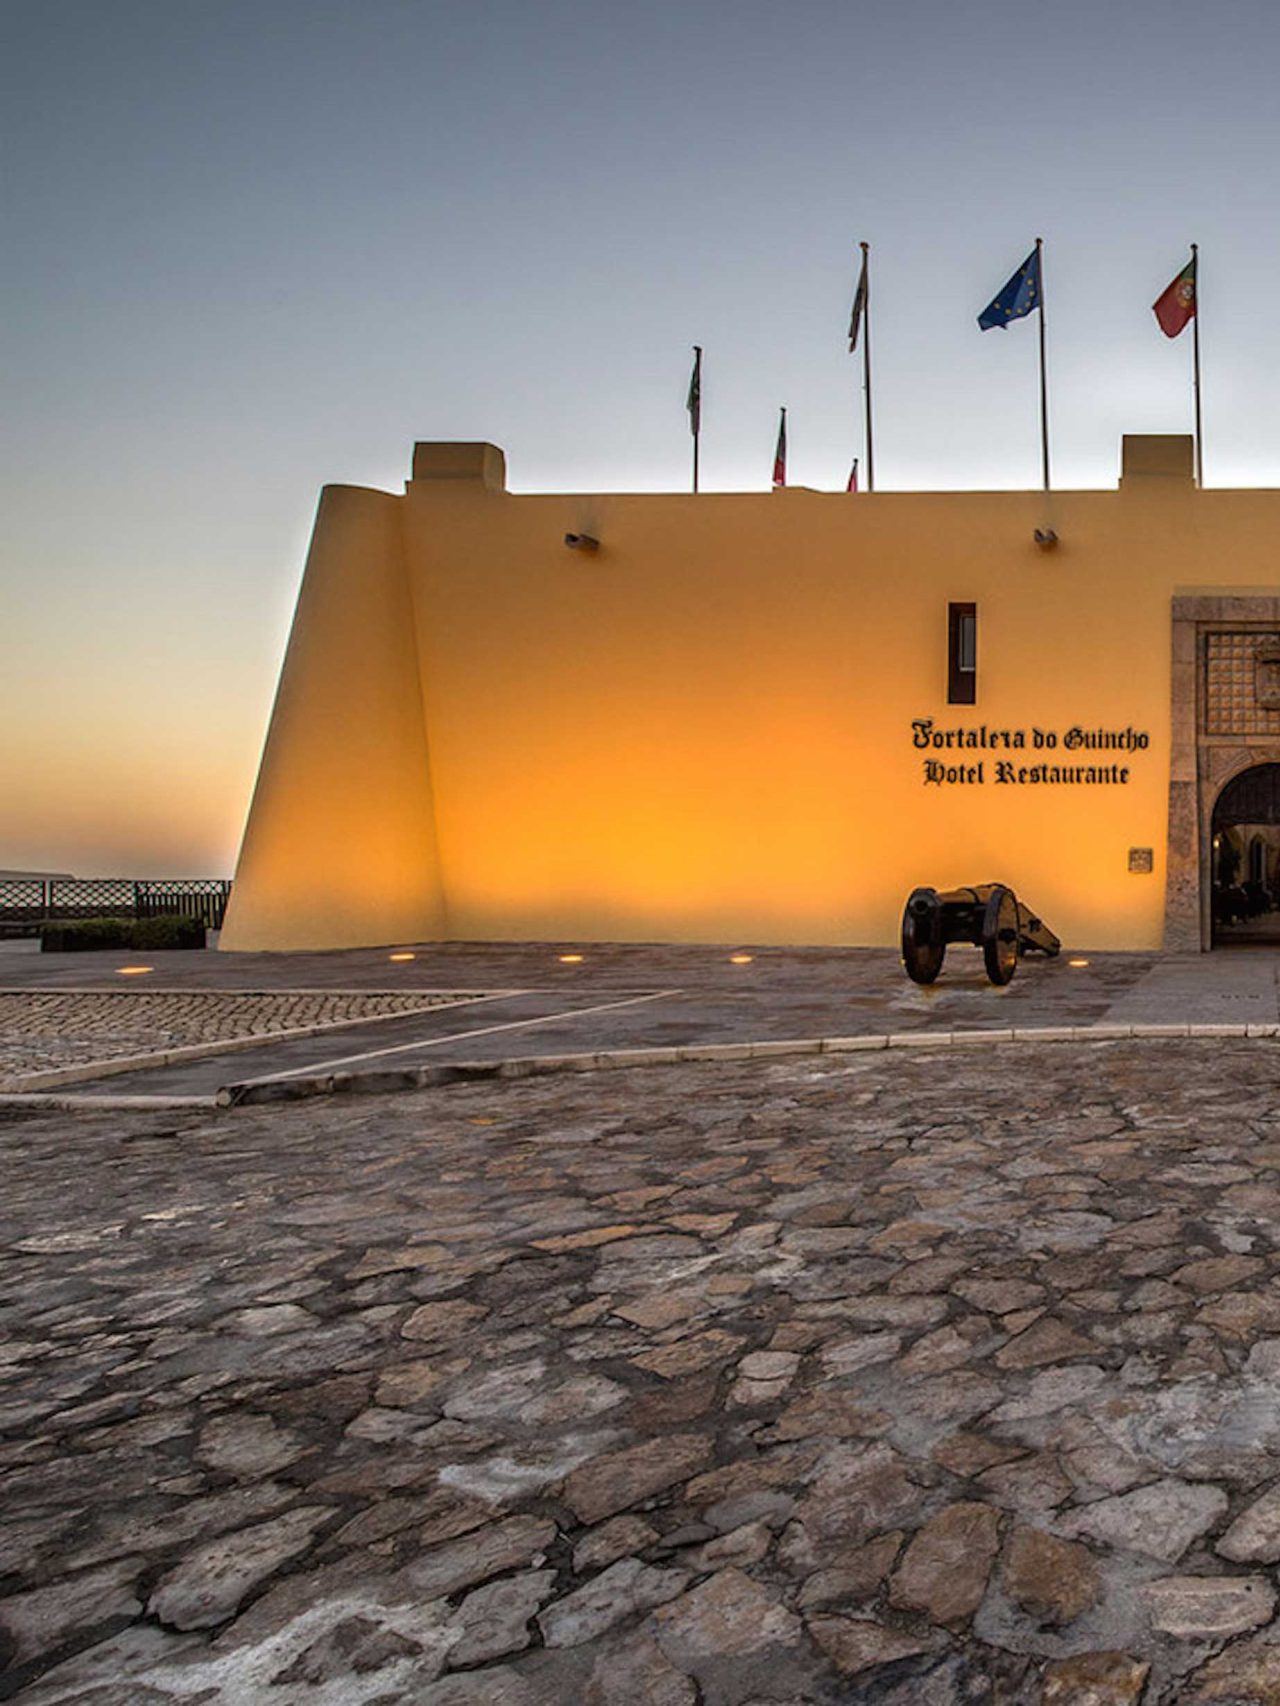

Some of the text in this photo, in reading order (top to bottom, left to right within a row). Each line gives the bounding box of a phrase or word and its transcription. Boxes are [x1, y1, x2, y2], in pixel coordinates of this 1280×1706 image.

[1032, 727, 1057, 749] do
[1064, 727, 1149, 753] Guincho
[923, 759, 1129, 786] Hotel Restaurante
